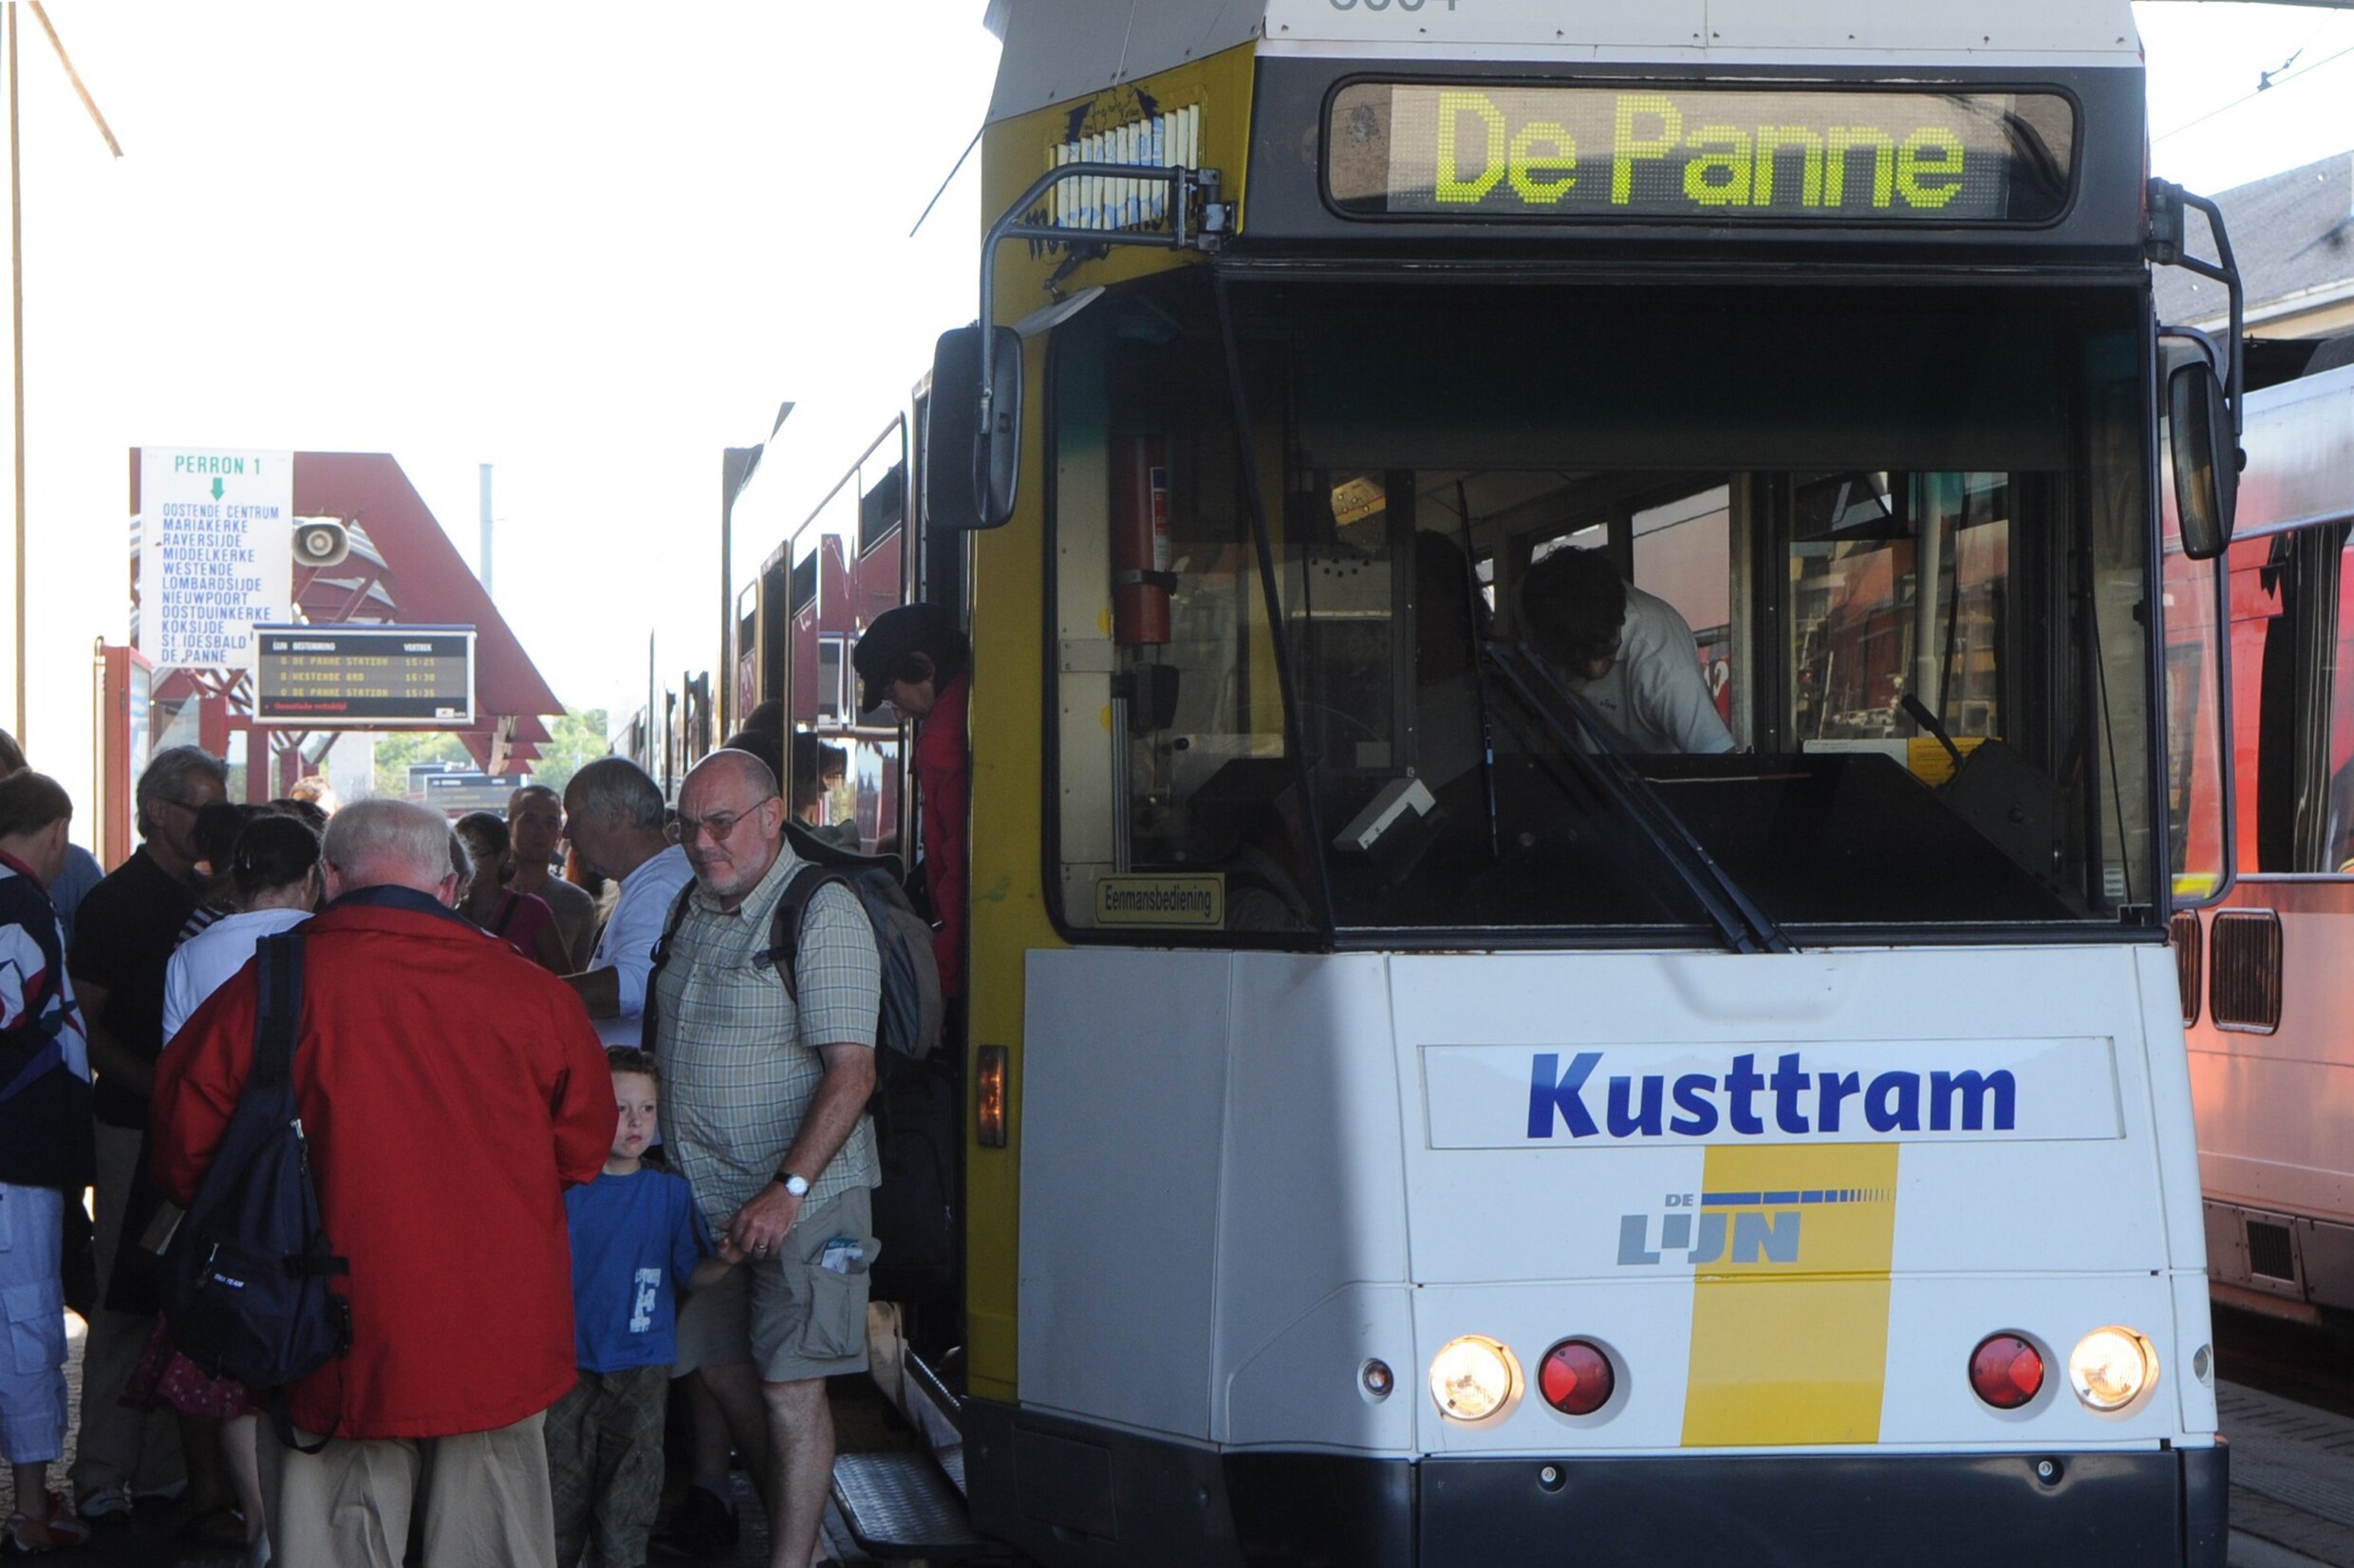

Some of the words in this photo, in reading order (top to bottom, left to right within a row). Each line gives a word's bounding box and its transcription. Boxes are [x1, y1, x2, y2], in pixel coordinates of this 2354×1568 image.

[1437, 91, 1578, 204] De
[1611, 94, 1963, 208] Panne
[175, 456, 244, 474] PERRON
[254, 457, 260, 475] 1
[163, 503, 220, 517] OOSTENDE
[227, 505, 279, 518] CENTRUM
[163, 518, 248, 532] MARIAKERKE
[163, 532, 242, 547] RAVERSIJDE
[163, 548, 254, 562] MIDDELKERKE
[163, 562, 234, 576] WESTENDE
[162, 576, 262, 591] LOMBARDSIJDE
[162, 591, 248, 606] NIEUWPOORT
[162, 606, 271, 620] OOSTDUINKERKE
[162, 621, 225, 634] KOKSIJDE
[161, 649, 177, 662] DE
[184, 650, 226, 663] PANNE
[1105, 885, 1211, 918] Eenmansbediening
[1526, 1051, 2017, 1139] Kusttram
[1665, 1194, 1693, 1207] DE
[1616, 1211, 1802, 1265] LIJN
[630, 1268, 661, 1333] F
